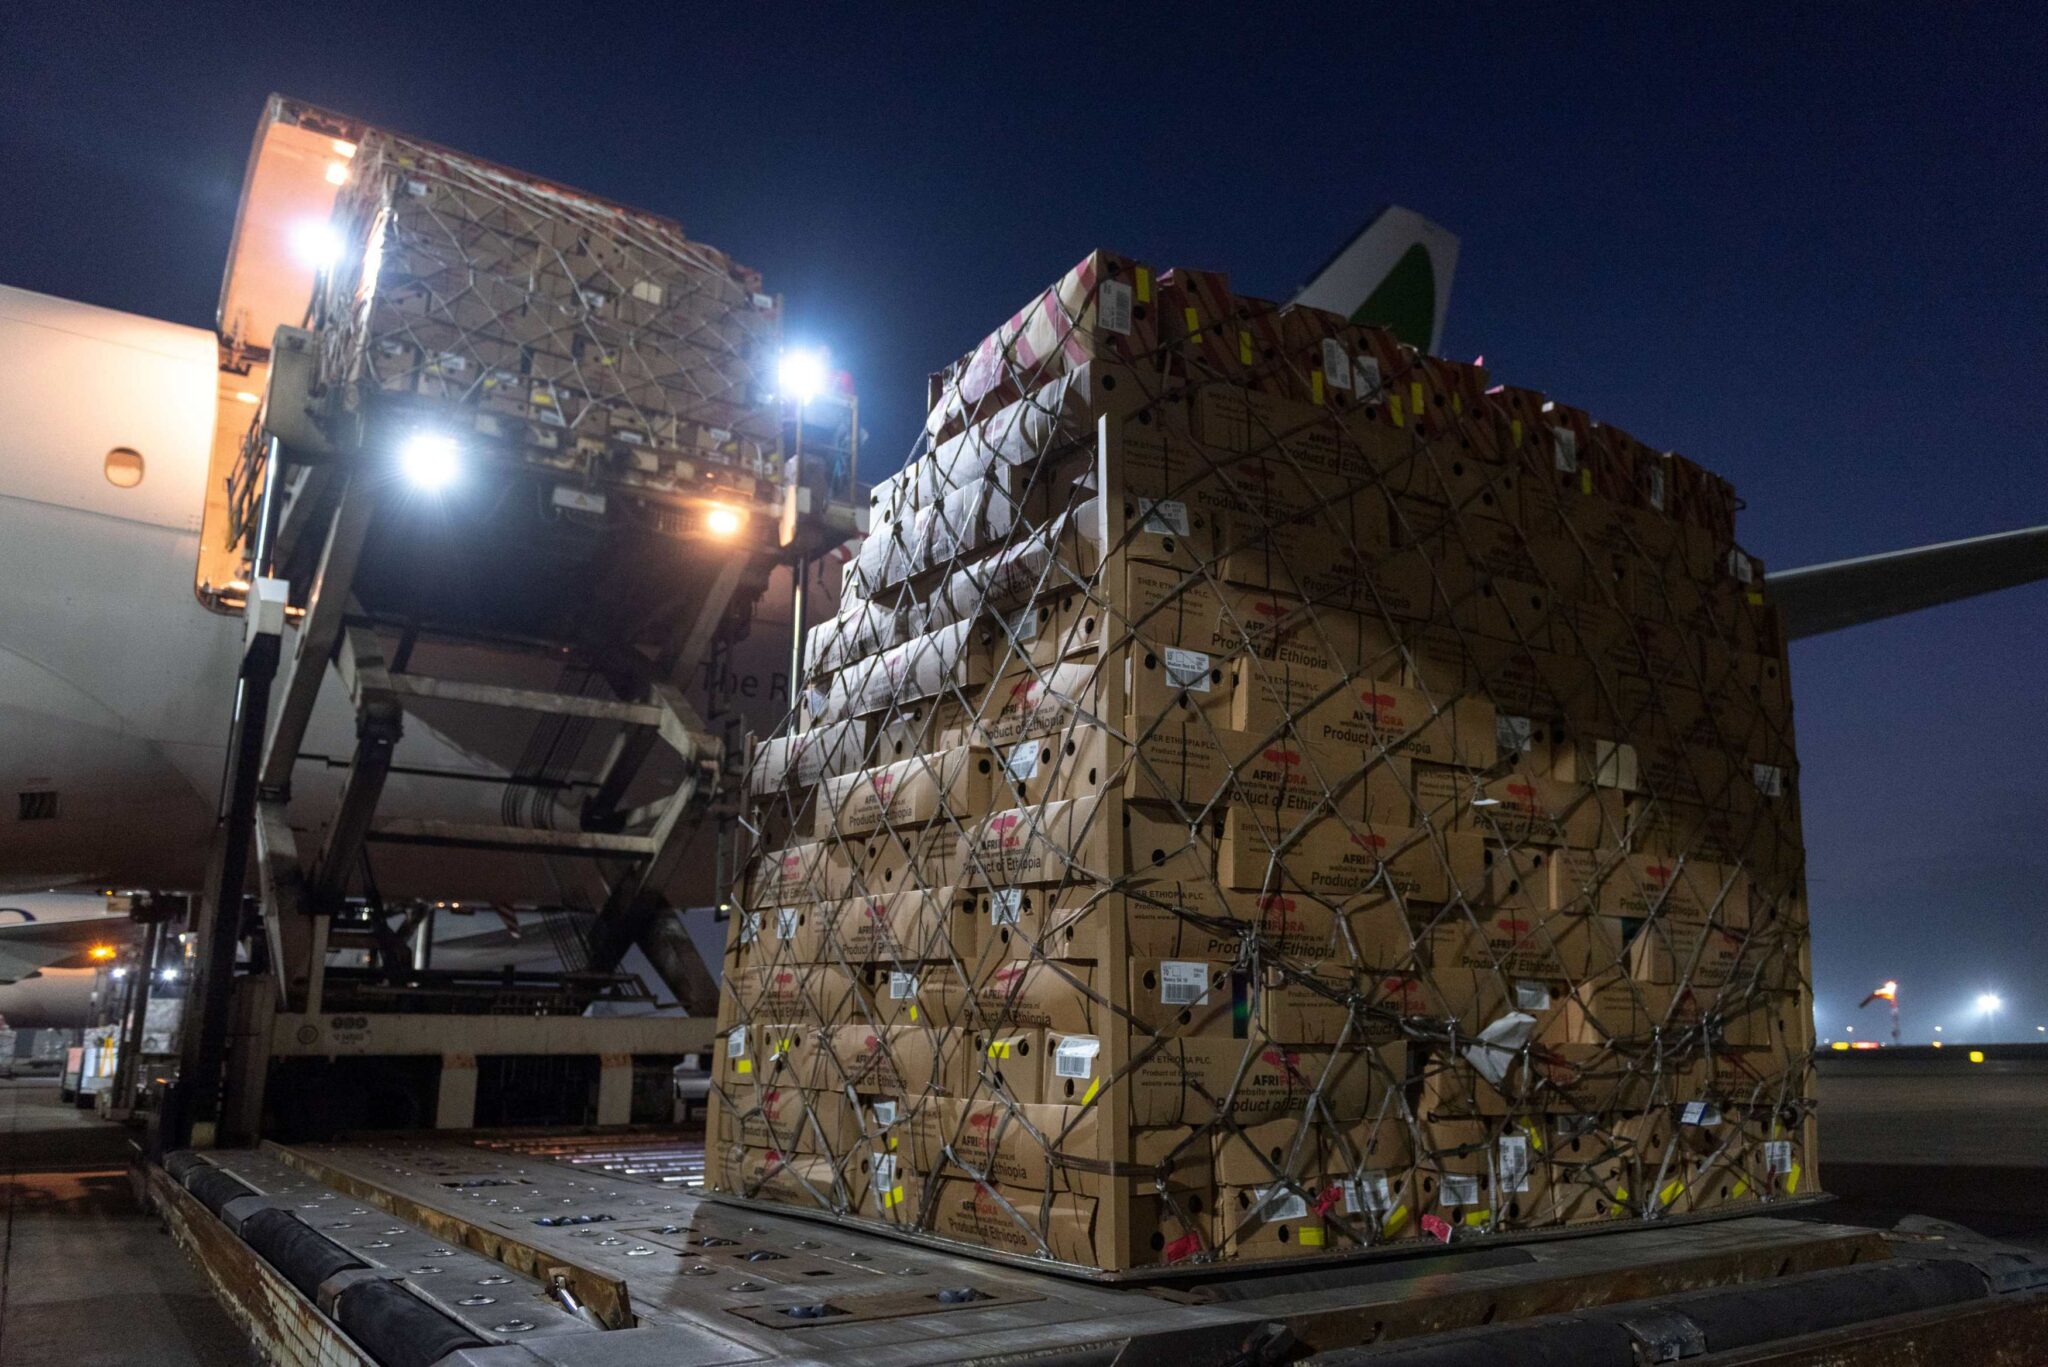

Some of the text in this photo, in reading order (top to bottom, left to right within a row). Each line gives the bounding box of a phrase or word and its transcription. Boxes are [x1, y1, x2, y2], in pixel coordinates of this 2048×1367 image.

[1279, 646, 1329, 670] Ethiopia
[769, 671, 790, 702] R
[1323, 724, 1369, 744] Product
[849, 814, 876, 826] Product
[1311, 872, 1360, 887] Product
[1195, 1056, 1212, 1065] PLC.
[1142, 1069, 1165, 1077] Product
